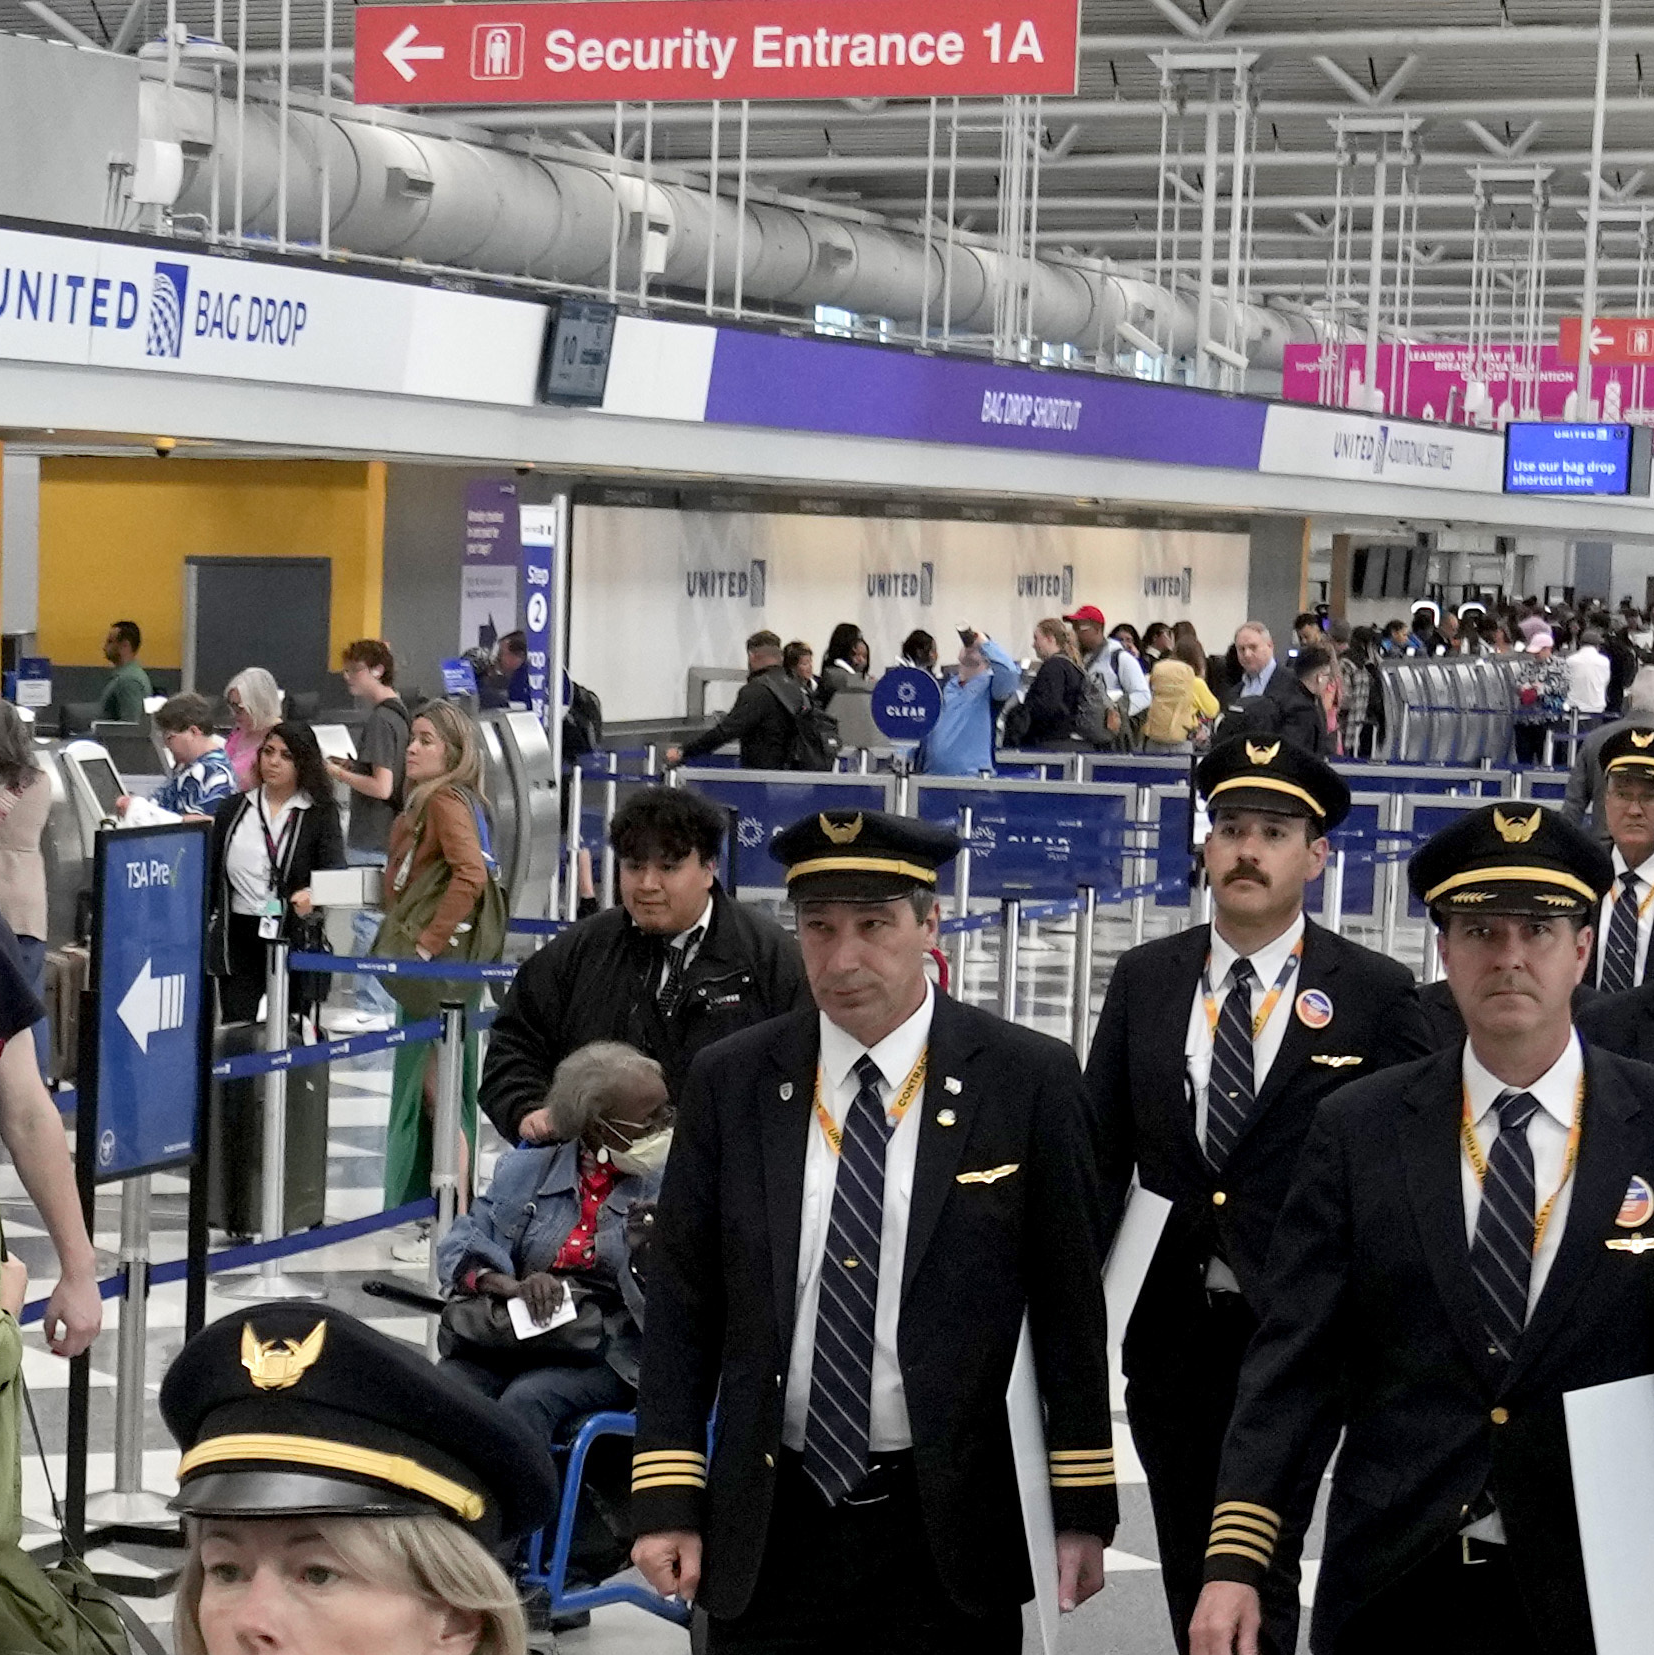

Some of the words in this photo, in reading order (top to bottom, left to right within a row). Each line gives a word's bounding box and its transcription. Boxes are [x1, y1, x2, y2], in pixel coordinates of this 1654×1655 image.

[546, 26, 737, 79] Security
[752, 26, 964, 70] Entrance
[982, 21, 1045, 65] 1A
[195, 290, 241, 340] BAG
[247, 296, 307, 347] DROP
[981, 390, 1006, 424] BAG
[1003, 392, 1033, 426] DROP
[1031, 396, 1082, 430] SHORTCUT
[1513, 459, 1536, 473] Use
[1538, 463, 1560, 473] our
[1562, 459, 1585, 476] bag
[1587, 459, 1616, 476] drop
[1513, 474, 1563, 486] shortcut
[1566, 474, 1594, 486] here
[686, 571, 748, 598] UNITED
[867, 573, 918, 597] UNITED
[1017, 574, 1061, 597] UNITED
[1145, 576, 1181, 597] UNITED
[533, 600, 542, 624] 2
[886, 704, 926, 718] CLEAR
[126, 861, 149, 888] TSA
[150, 859, 170, 886] Pre
[897, 1058, 928, 1108] CONTRAC
